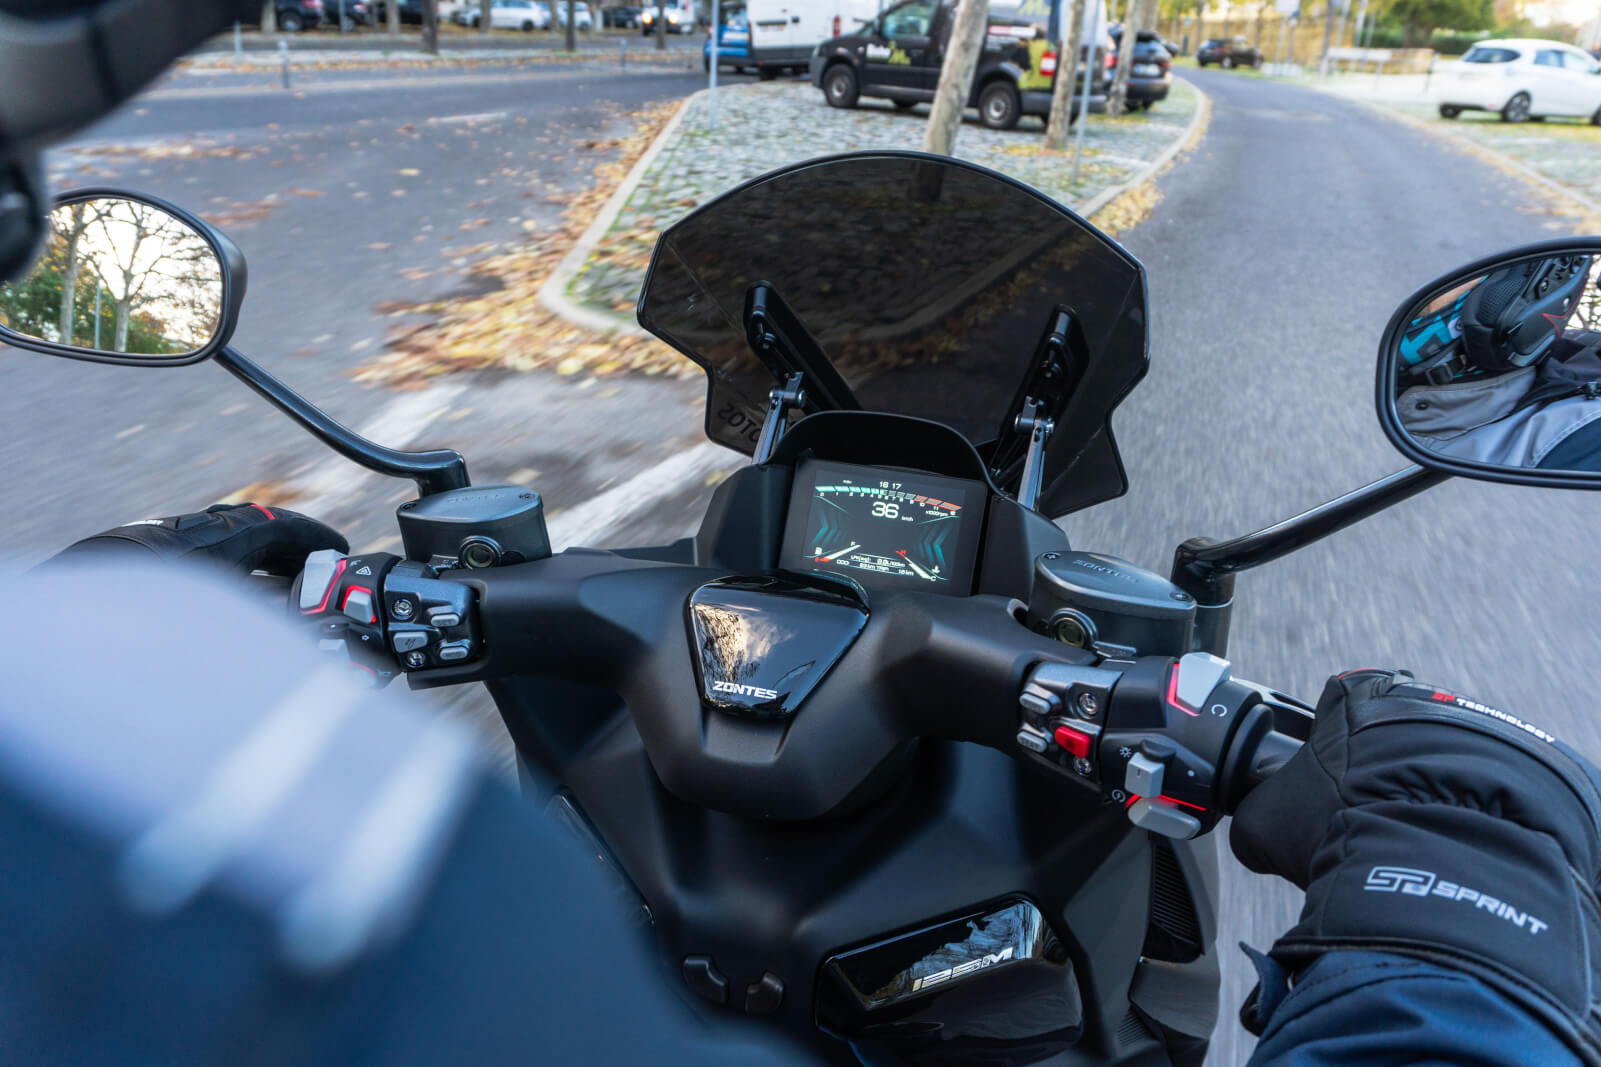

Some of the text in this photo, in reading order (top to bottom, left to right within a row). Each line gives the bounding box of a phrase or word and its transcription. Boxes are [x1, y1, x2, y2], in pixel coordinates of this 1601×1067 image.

[871, 501, 900, 519] 36
[712, 680, 778, 700] ZONTES
[1456, 698, 1556, 744] TECHNOLOGY
[1431, 880, 1549, 936] SPRINT
